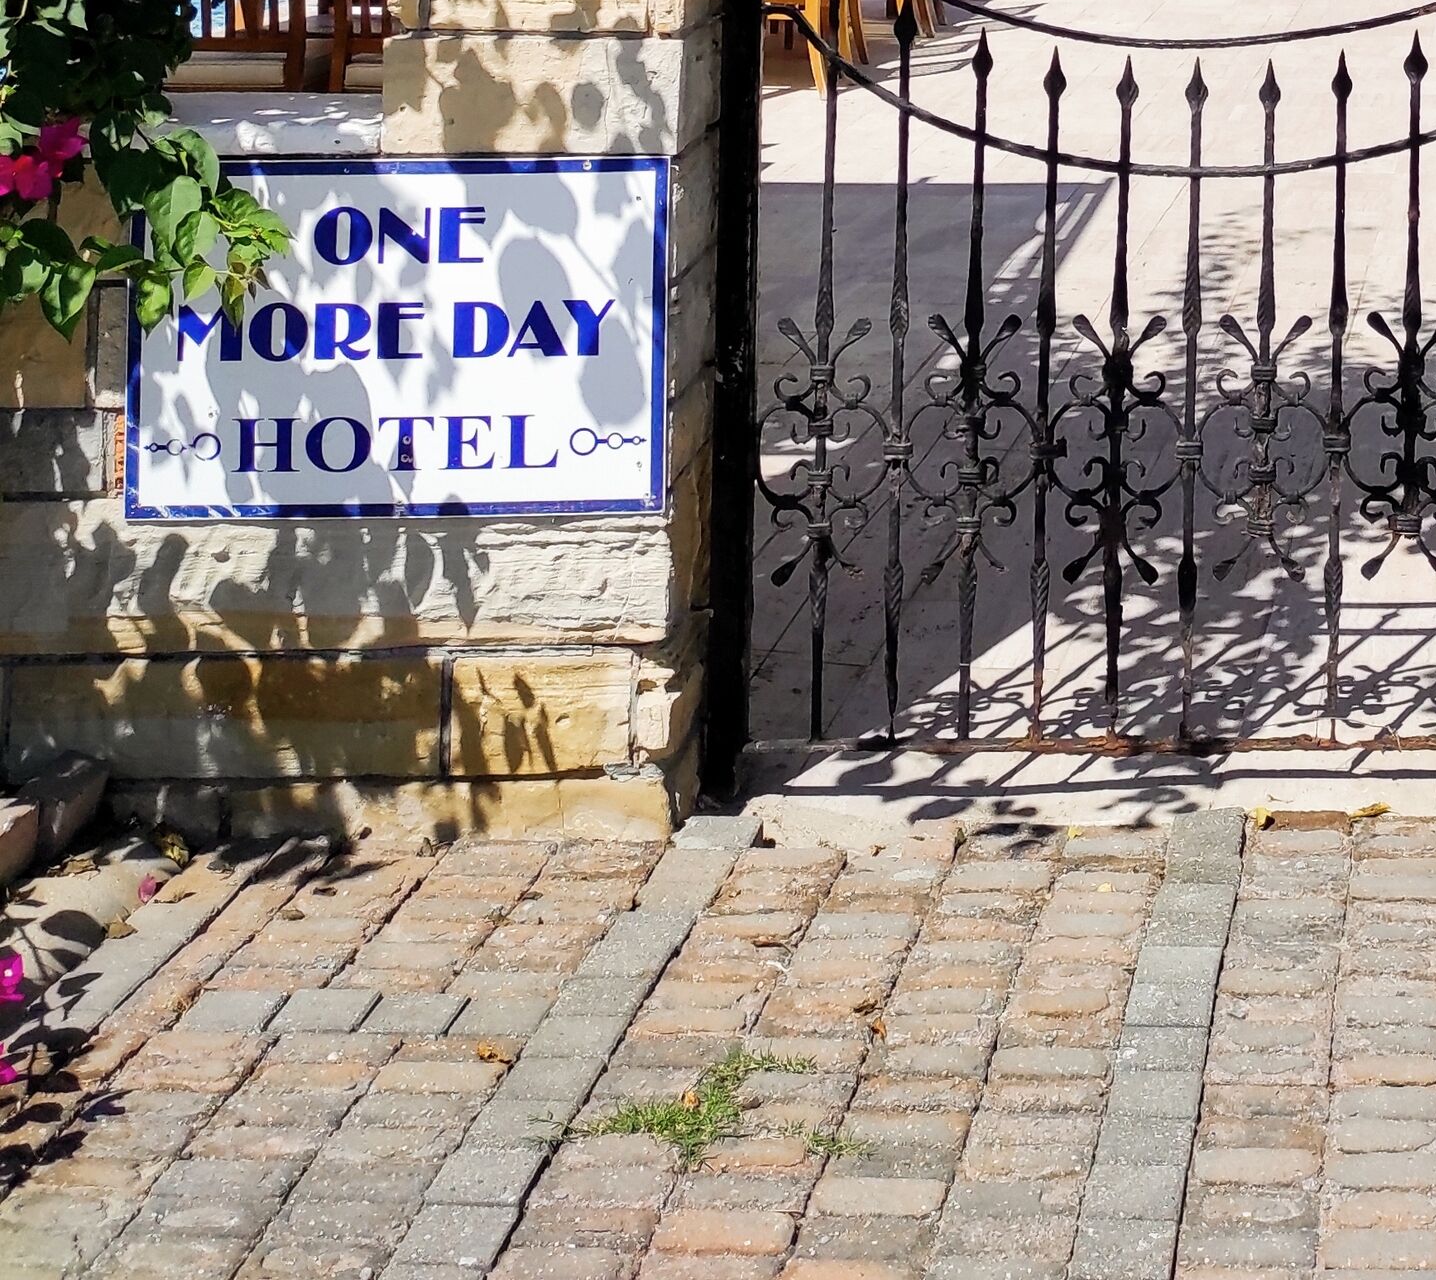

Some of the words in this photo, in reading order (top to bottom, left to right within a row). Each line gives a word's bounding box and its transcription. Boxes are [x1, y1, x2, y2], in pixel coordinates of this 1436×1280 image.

[313, 205, 486, 266] ONE
[177, 301, 426, 363] MORE
[451, 299, 617, 359] DAY
[231, 414, 560, 474] HOTEL
